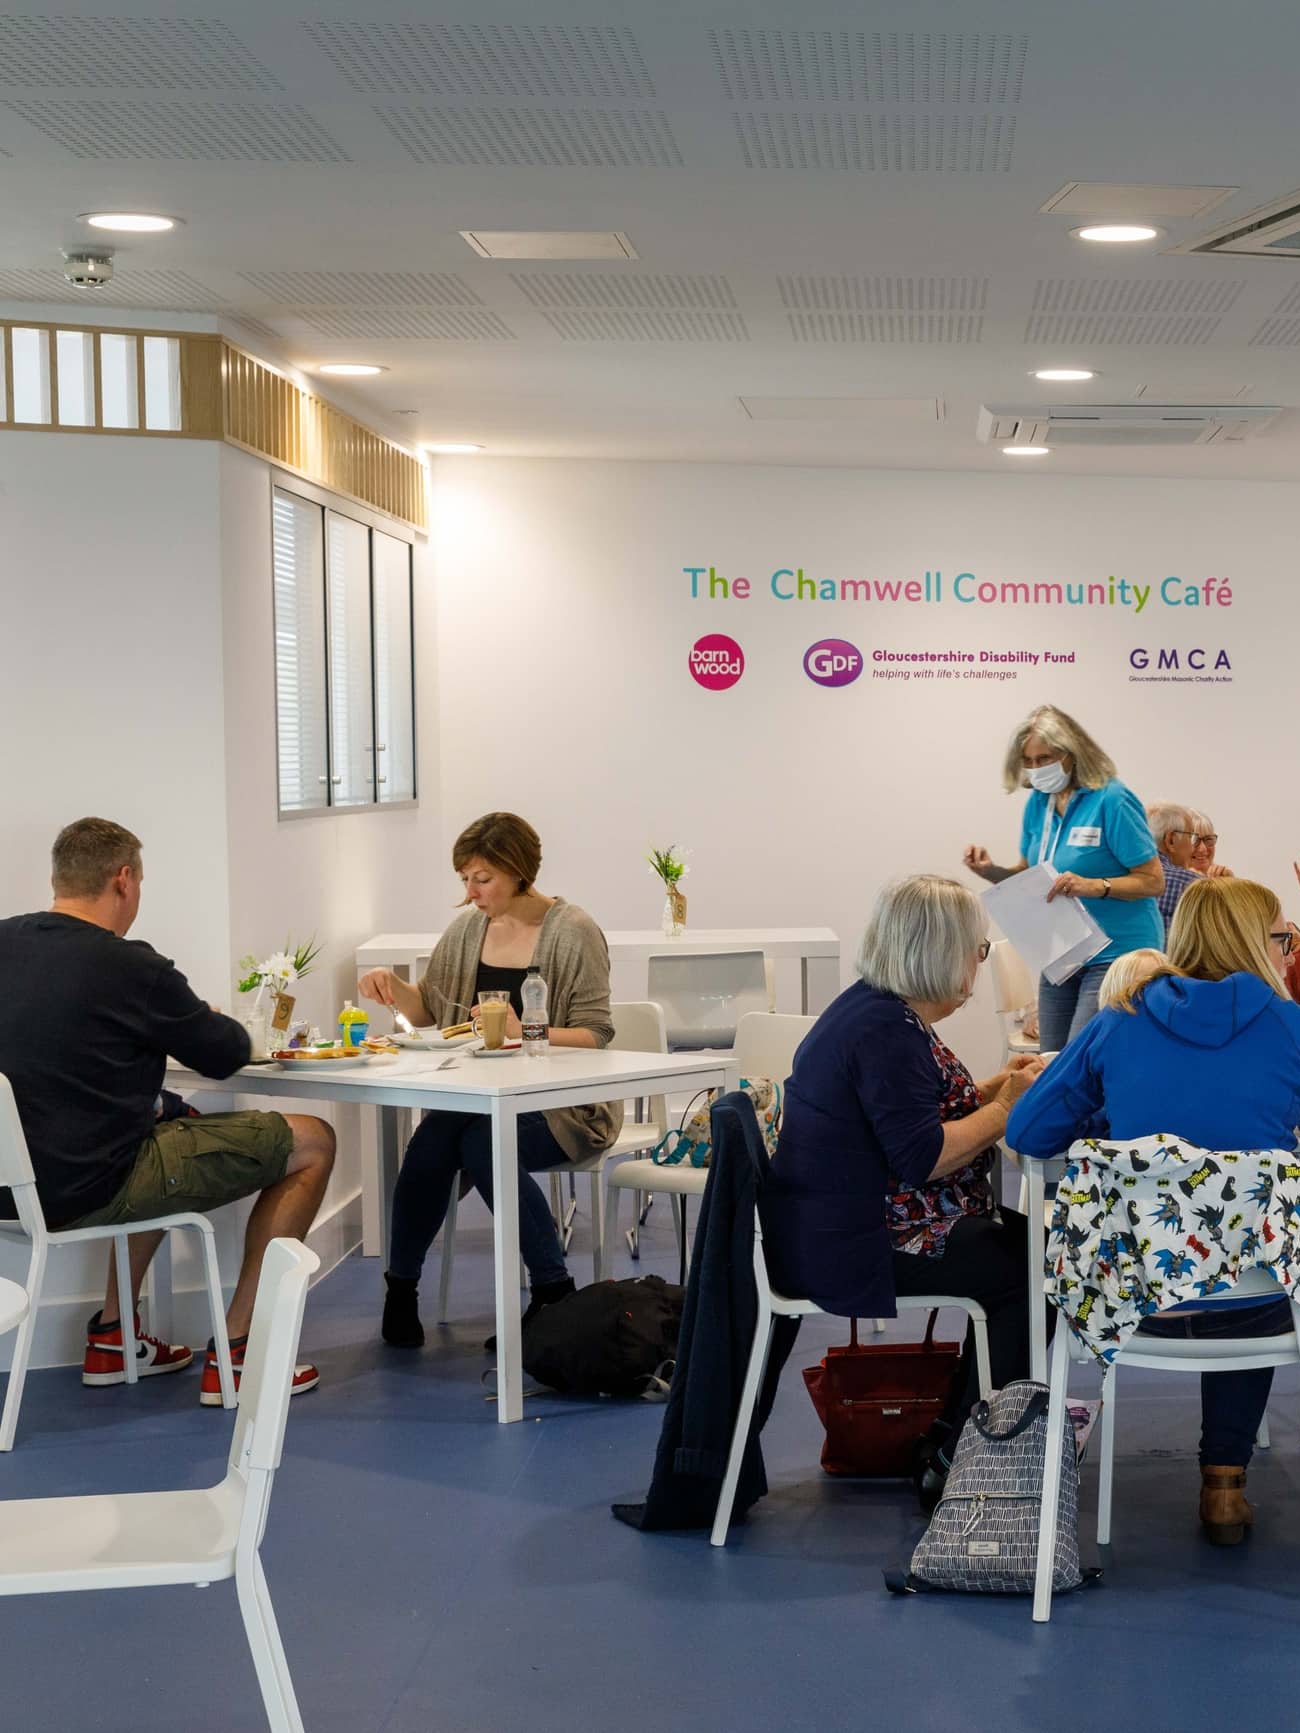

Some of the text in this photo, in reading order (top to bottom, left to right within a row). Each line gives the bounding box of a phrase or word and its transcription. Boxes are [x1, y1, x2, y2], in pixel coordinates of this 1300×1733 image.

[683, 567, 1233, 613] The Chamwell Community Café
[691, 649, 729, 662] barn
[808, 649, 858, 677] GDF
[872, 649, 1075, 665] Gloucestershire Disability Fund
[694, 657, 740, 675] wood
[872, 669, 1017, 681] helping with life's challenges
